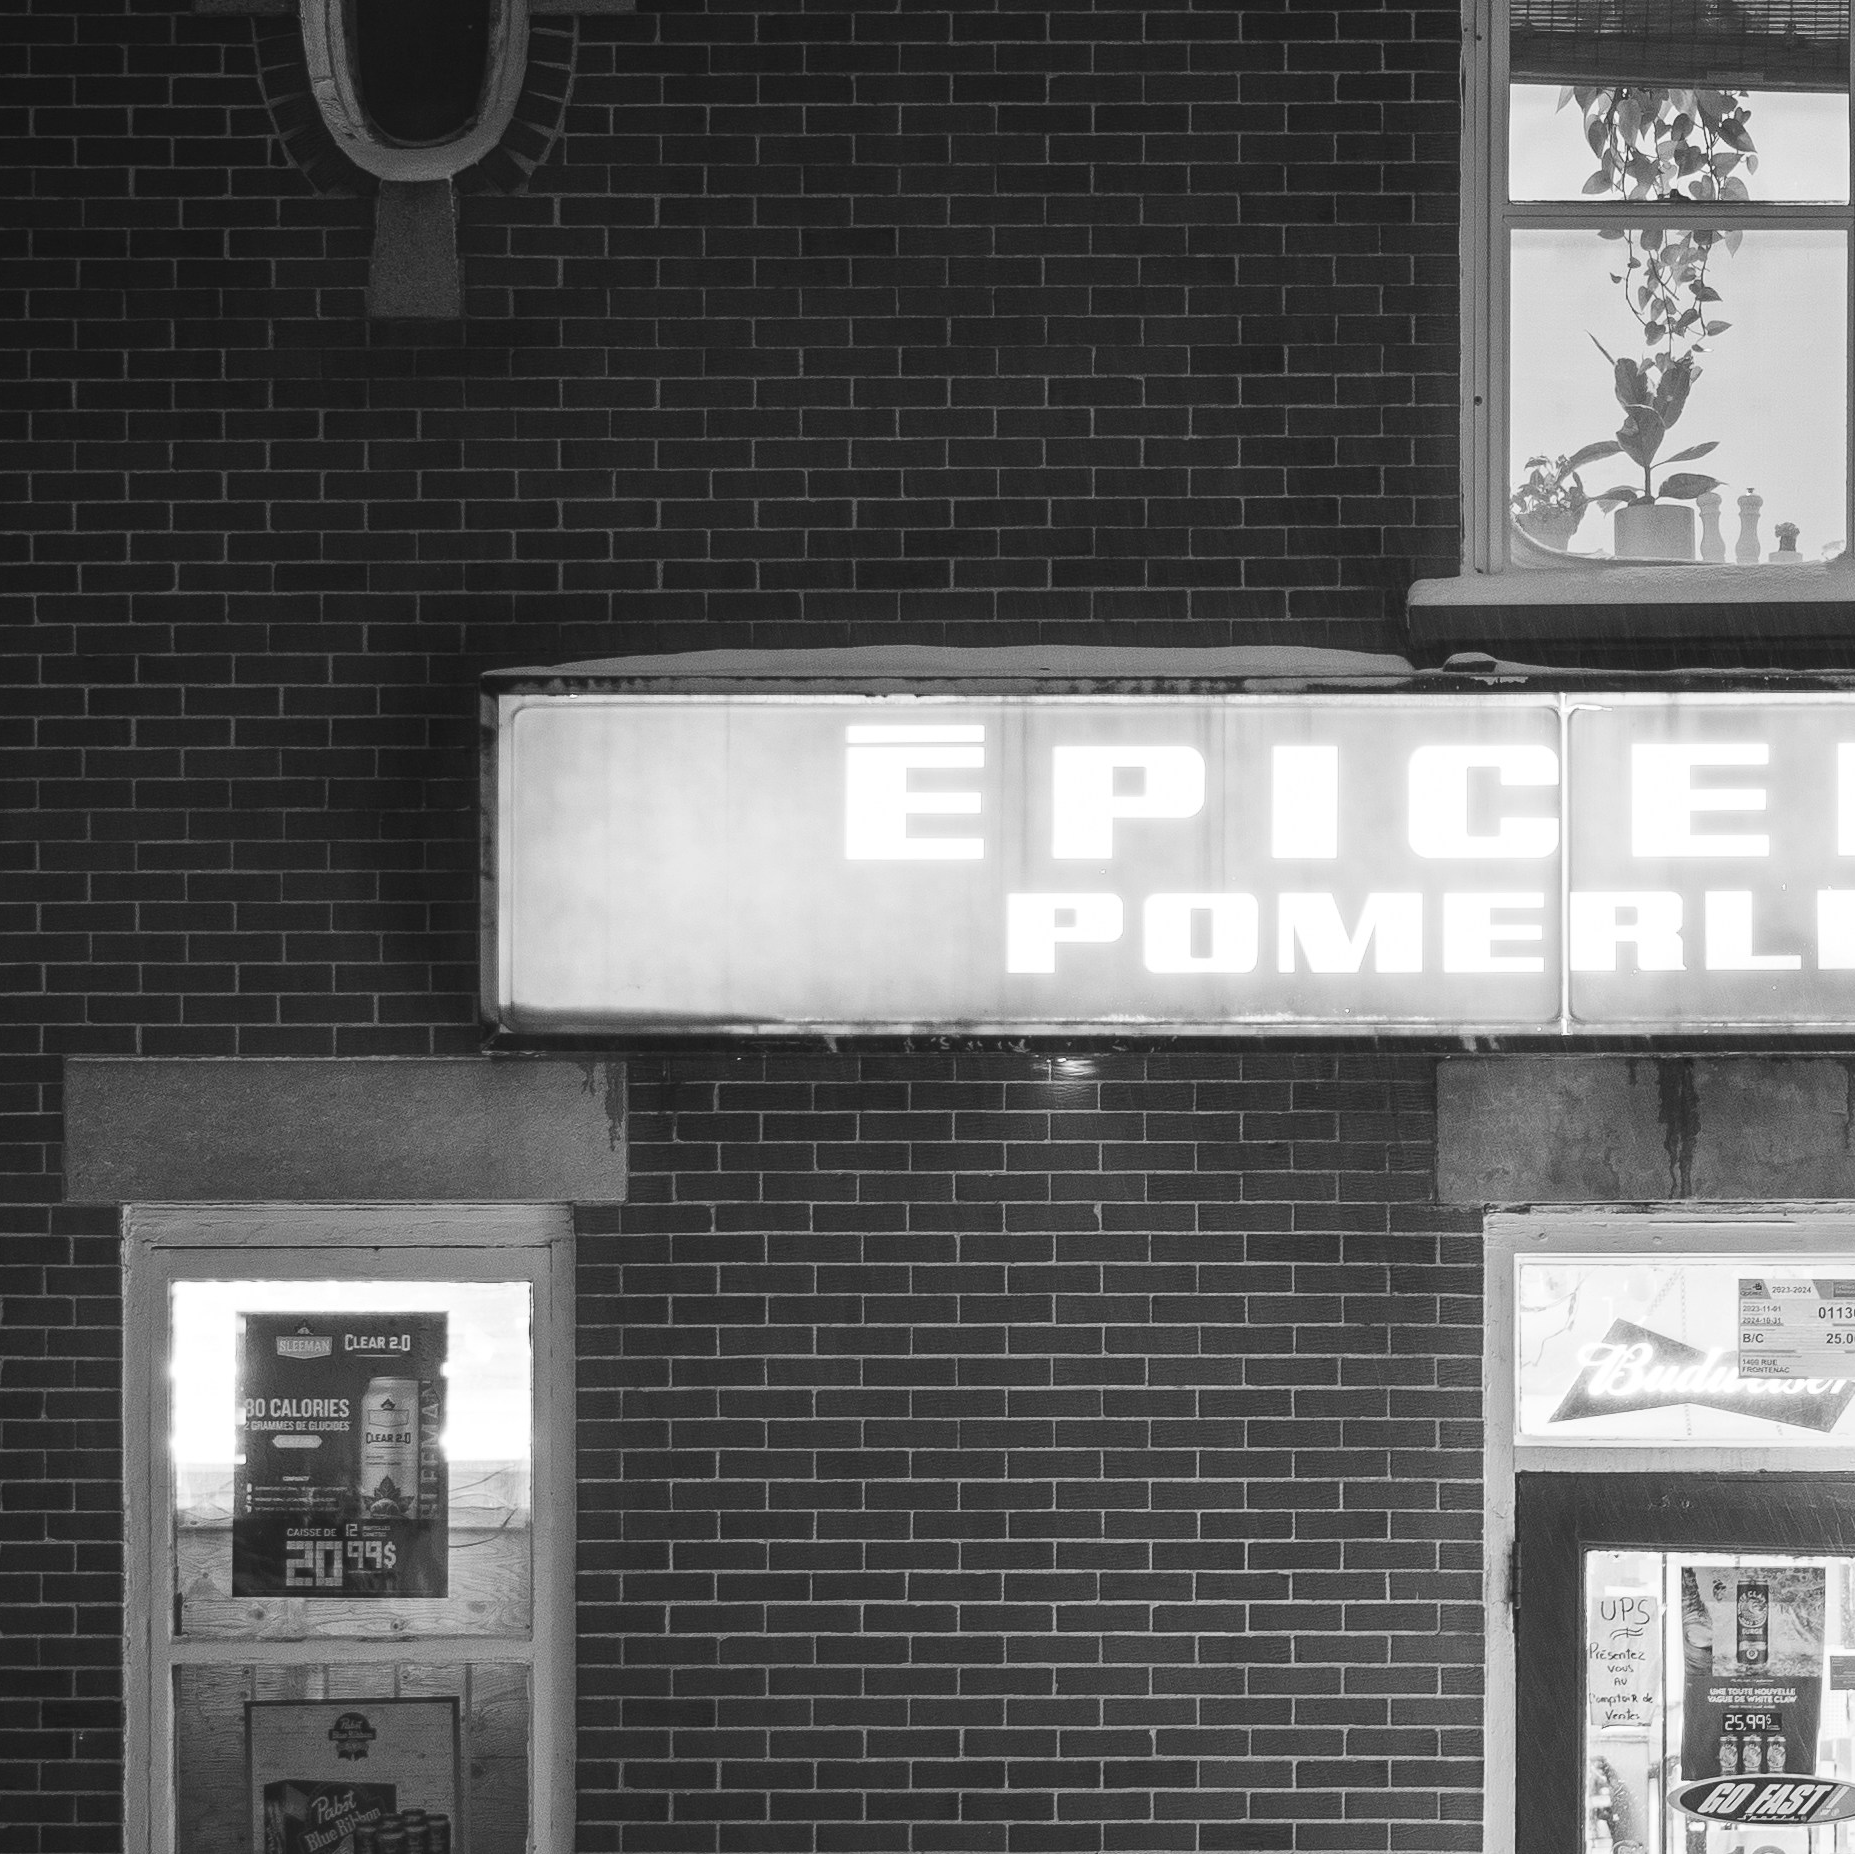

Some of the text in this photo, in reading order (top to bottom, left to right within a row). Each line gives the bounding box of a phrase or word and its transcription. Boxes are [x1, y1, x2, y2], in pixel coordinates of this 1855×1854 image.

[344, 1333, 411, 1352] CLEAR 2.0
[1742, 1333, 1764, 1344] B/C
[279, 1340, 331, 1352] SLEEMAN
[1761, 1358, 1778, 1366] RUE
[1742, 1366, 1791, 1374] FRONTENAC
[269, 1398, 351, 1418] CALORIES
[296, 1420, 307, 1431] DE
[287, 1523, 358, 1537] CAISSE DE 12
[1600, 1596, 1651, 1625] UPS
[1589, 1641, 1646, 1661] Présentez
[1709, 1687, 1796, 1695] UNE TOUTE NOUVELLE
[1642, 1692, 1654, 1704] de
[1707, 1695, 1798, 1703] VAGUE DE WHITE CLAW
[1605, 1708, 1640, 1721] Ventes
[1696, 1782, 1756, 1814] GO
[310, 1789, 358, 1824] Pabst
[303, 1827, 339, 1852] Blue
